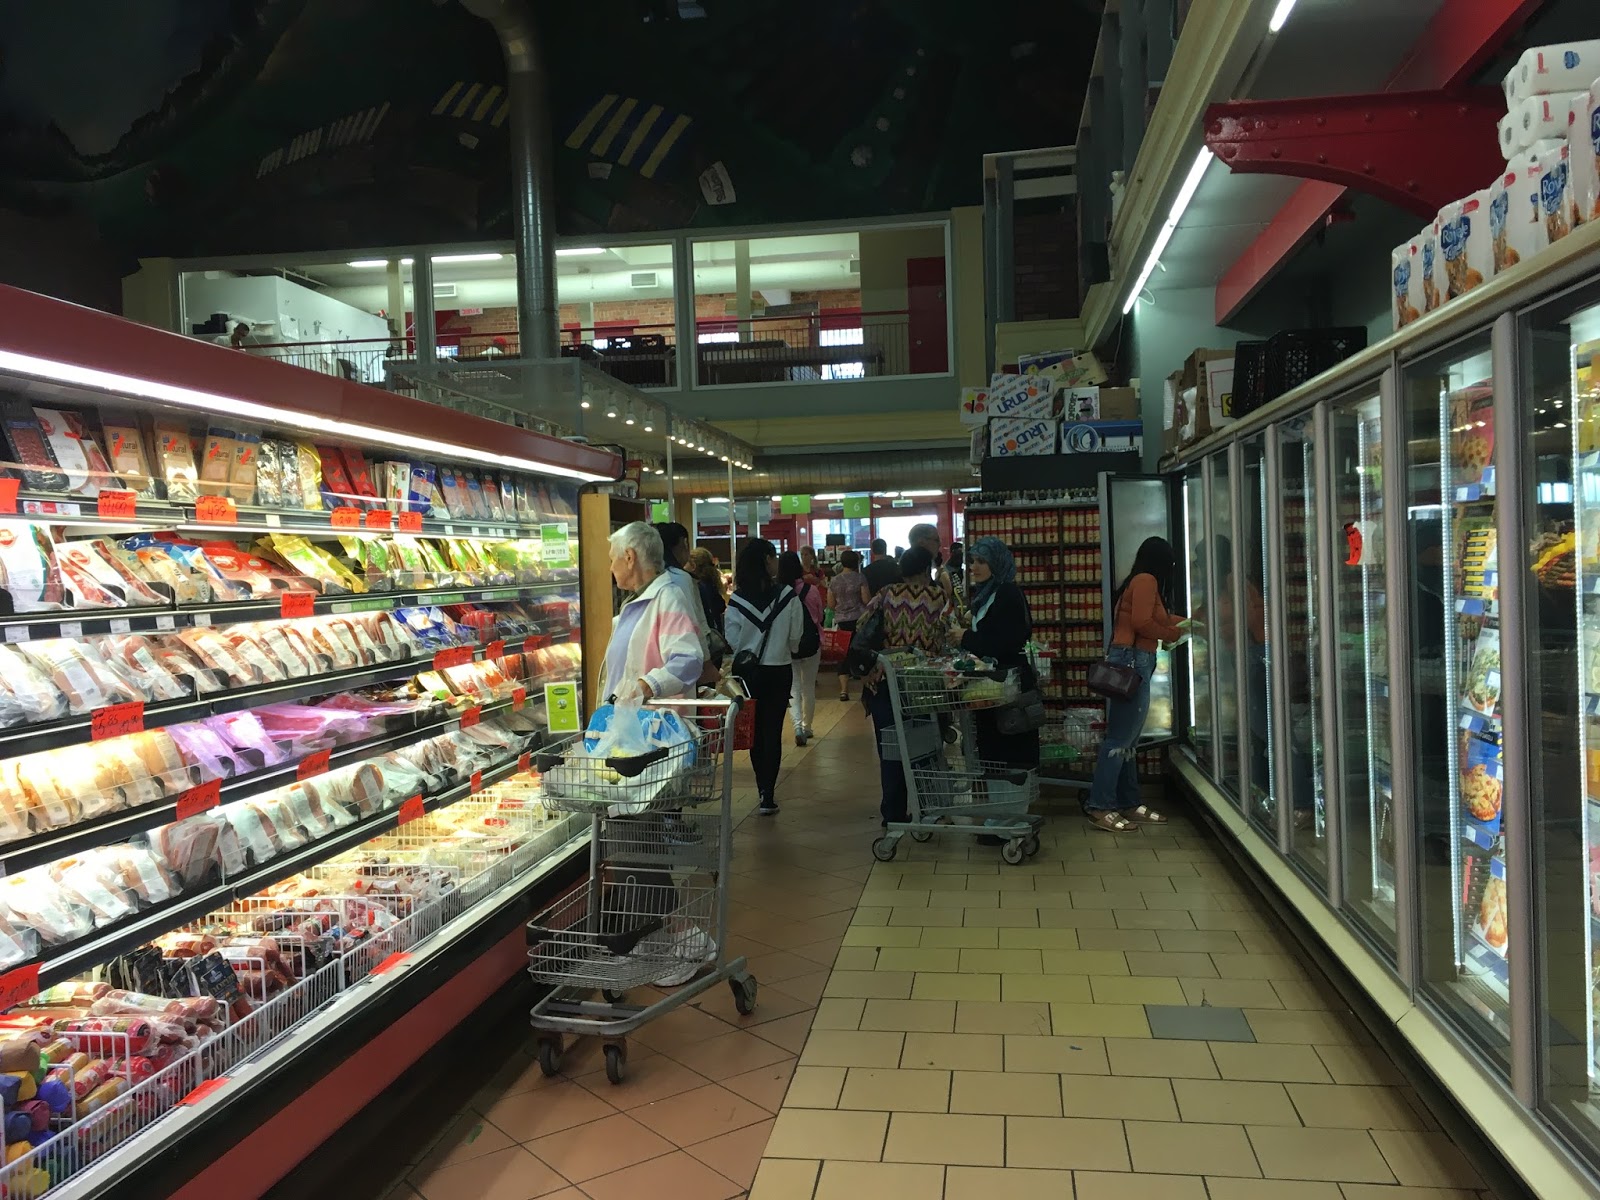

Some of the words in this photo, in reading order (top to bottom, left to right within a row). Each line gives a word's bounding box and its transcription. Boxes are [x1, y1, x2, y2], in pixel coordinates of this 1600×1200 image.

[163, 444, 187, 453] ntural
[792, 496, 799, 507] 5
[853, 502, 860, 512] 6
